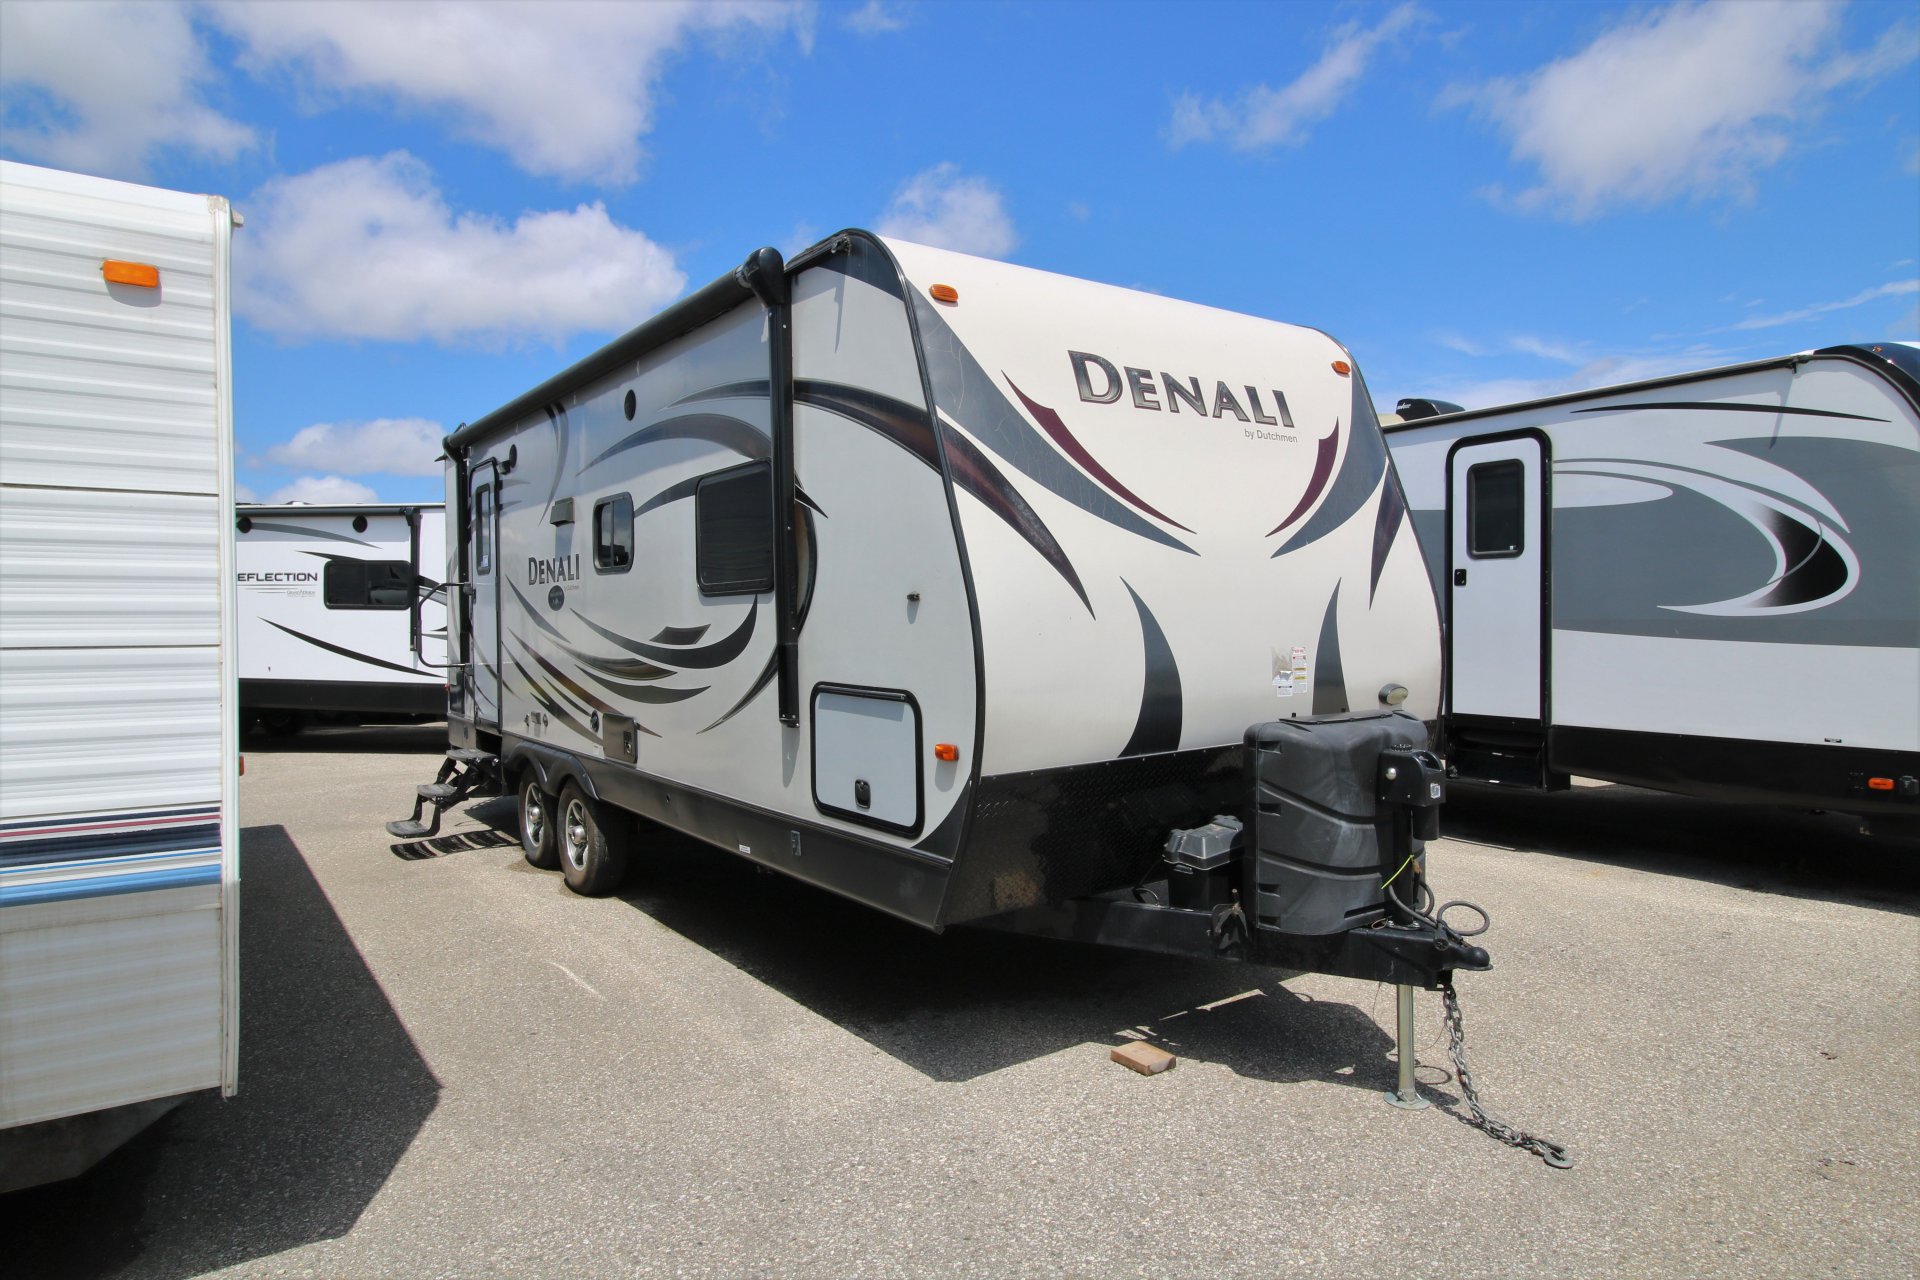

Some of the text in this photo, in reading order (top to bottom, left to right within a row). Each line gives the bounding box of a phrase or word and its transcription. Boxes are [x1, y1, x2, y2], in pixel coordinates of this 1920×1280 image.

[1067, 349, 1296, 429] DENALI
[1244, 428, 1298, 443] by Dutchmen
[237, 572, 318, 582] EFLECTION
[528, 553, 580, 586] DENALI
